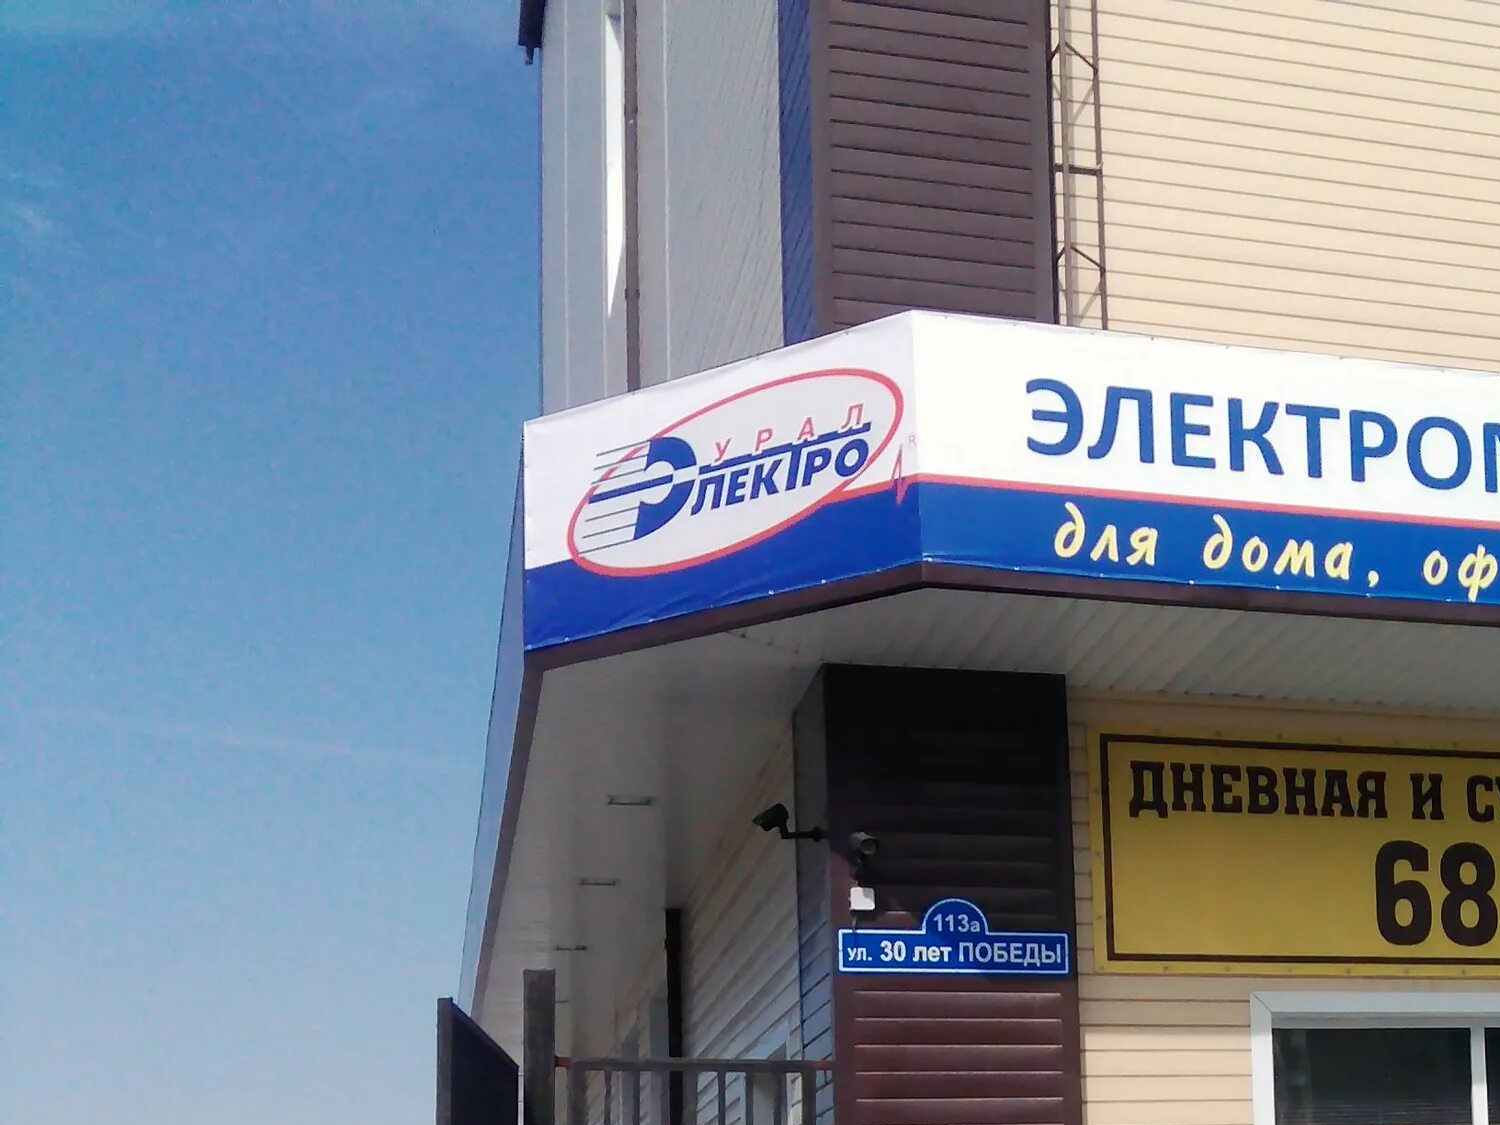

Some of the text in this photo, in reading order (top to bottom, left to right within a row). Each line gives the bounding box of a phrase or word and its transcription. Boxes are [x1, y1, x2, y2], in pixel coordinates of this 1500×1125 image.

[714, 403, 865, 464] УРАЛ
[1053, 502, 1158, 566] для
[1201, 515, 1380, 588] дома,
[1128, 761, 1390, 819] ДНЕВНАЯ
[1409, 772, 1444, 820] И
[932, 913, 981, 933] 113а
[847, 940, 1062, 967] ул. 30 лет ПОБЕДЫ
